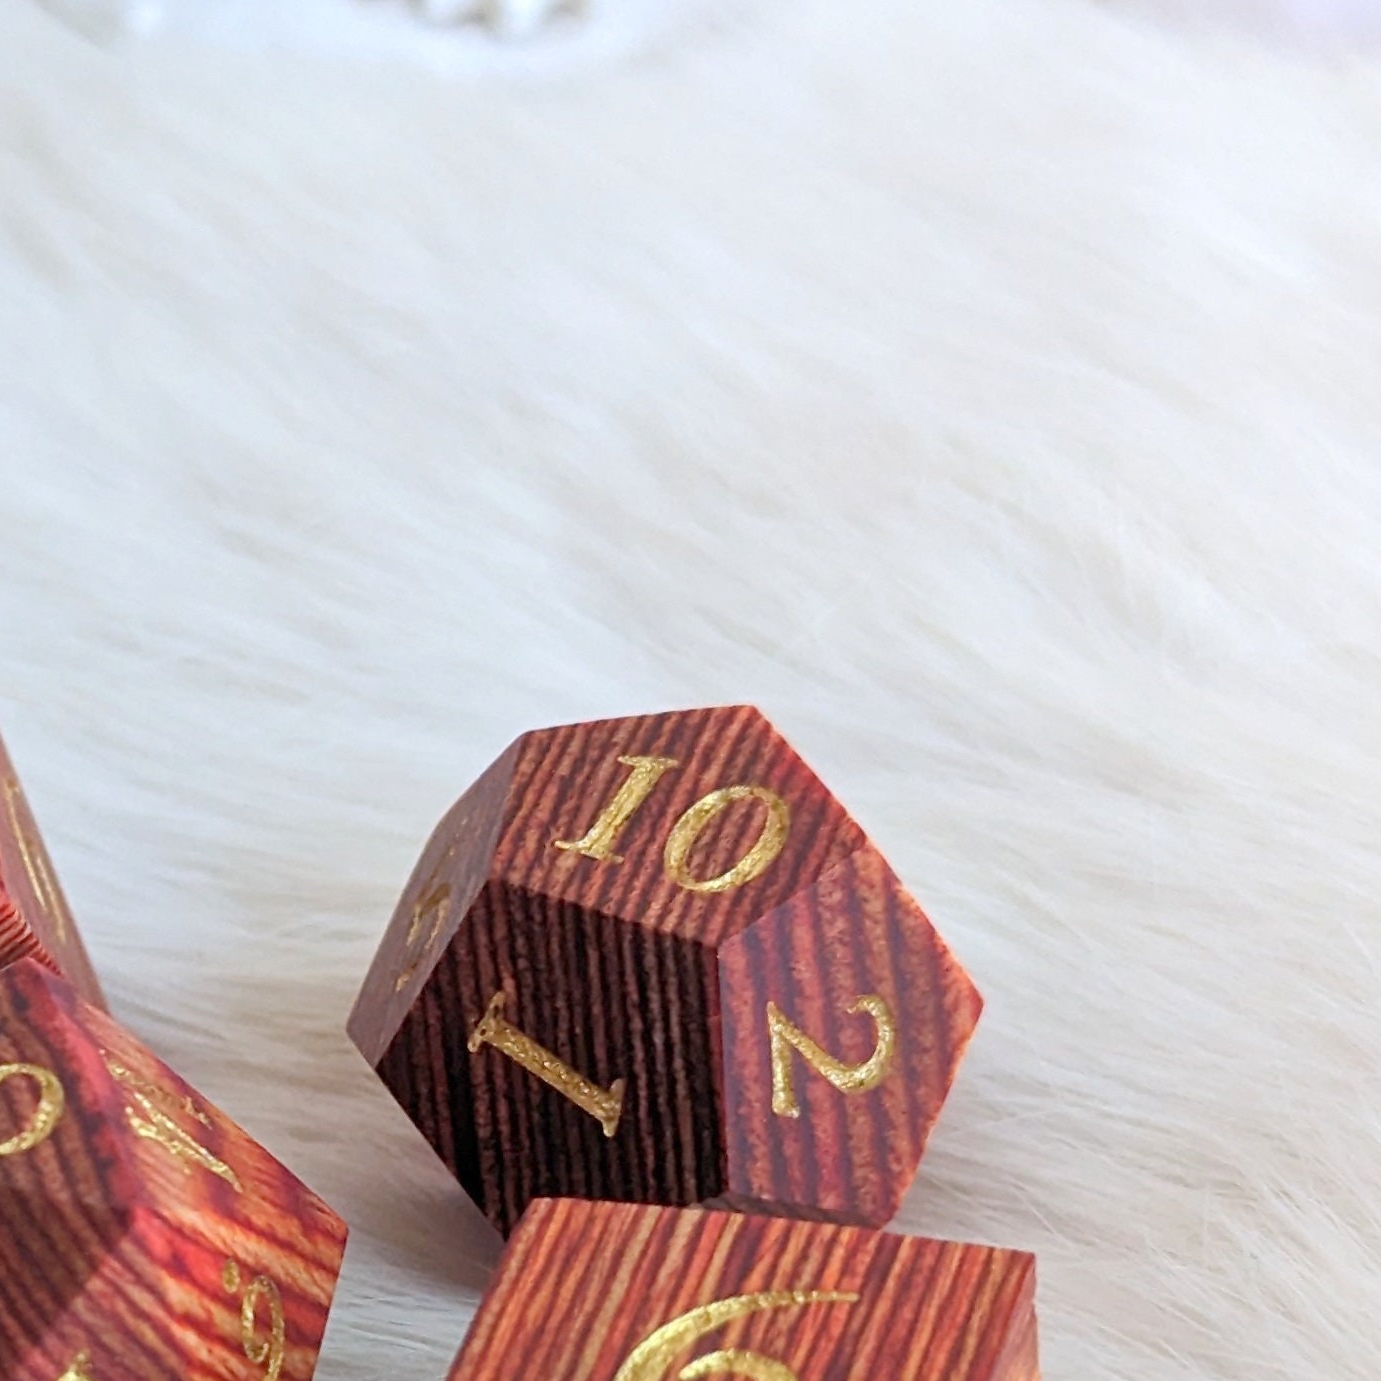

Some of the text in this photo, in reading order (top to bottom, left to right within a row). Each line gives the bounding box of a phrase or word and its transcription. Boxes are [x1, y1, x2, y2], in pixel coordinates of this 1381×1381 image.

[551, 755, 789, 893] 10
[467, 991, 622, 1137] 1
[766, 994, 896, 1120] 2
